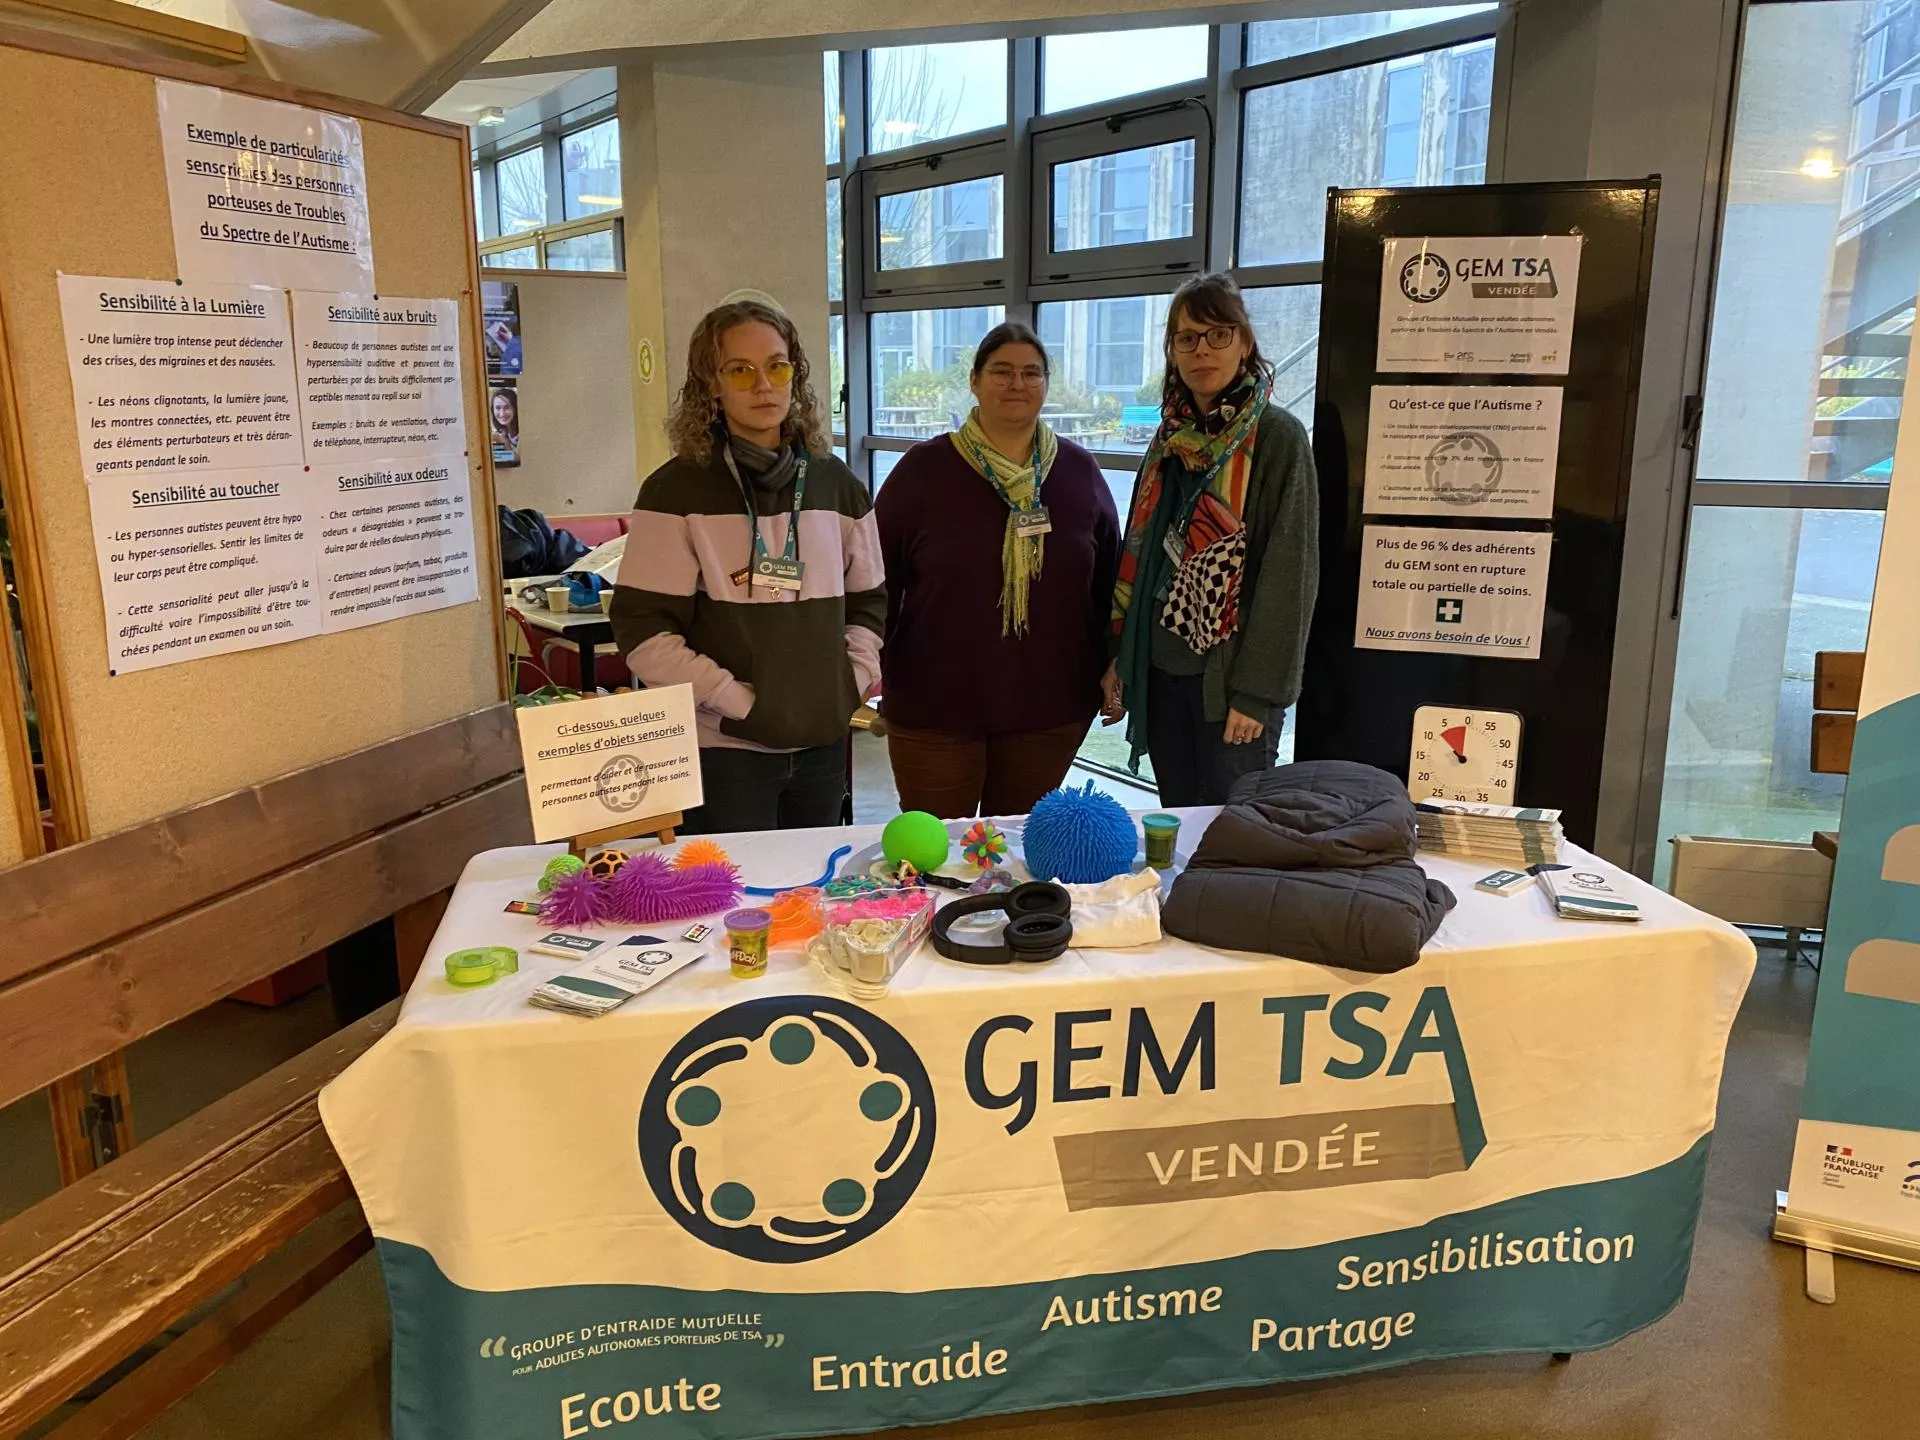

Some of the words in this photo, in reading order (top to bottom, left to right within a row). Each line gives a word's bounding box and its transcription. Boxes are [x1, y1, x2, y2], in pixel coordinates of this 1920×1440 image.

[187, 123, 246, 148] Exemple
[251, 135, 266, 150] de
[270, 140, 350, 165] particularités
[296, 175, 354, 194] personnes
[207, 194, 272, 213] porteuses
[276, 200, 291, 215] de
[295, 202, 345, 222] Troubles
[200, 222, 218, 238] du
[222, 224, 270, 244] Spectre
[274, 230, 289, 244] de
[1456, 258, 1503, 282] GEM
[1488, 285, 1536, 295] VENDÉE
[100, 292, 176, 311] Sensibilité
[181, 297, 189, 311] à
[194, 298, 206, 311] la
[211, 299, 264, 315] Lumière
[328, 306, 380, 321] Sensibilité
[383, 313, 403, 322] aux
[407, 310, 437, 323] bruits
[88, 334, 109, 344] Une
[113, 335, 150, 345] lumière
[154, 337, 174, 346] trop
[177, 336, 211, 346] intense
[215, 337, 236, 348] peut
[239, 337, 283, 348] déclencher
[83, 355, 101, 365] des
[105, 356, 136, 367] crises,
[140, 356, 155, 366] des
[159, 357, 205, 368] migraines
[208, 358, 218, 366] et
[221, 357, 236, 366] des
[239, 358, 275, 366] nausées.
[98, 397, 114, 406] Les
[120, 396, 149, 406] néons
[154, 395, 209, 407] clignotants,
[214, 395, 222, 404] la
[226, 393, 260, 404] lumière
[263, 394, 288, 405] jaune,
[1449, 402, 1470, 411] que
[1536, 401, 1542, 410] ?
[91, 418, 105, 427] les
[112, 417, 153, 427] montres
[157, 415, 212, 426] connectées,
[216, 415, 232, 423] etc.
[237, 414, 271, 424] peuvent
[275, 413, 290, 421] être
[94, 439, 112, 449] des
[117, 436, 162, 448] éléments
[166, 434, 229, 446] perturbateurs
[234, 434, 242, 442] et
[246, 432, 262, 441] très
[266, 431, 292, 440] déran-
[96, 460, 132, 472] geants
[136, 457, 175, 470] pendant
[178, 456, 186, 465] le
[189, 455, 210, 464] soin.
[338, 471, 392, 488] Sensibilité
[395, 472, 412, 482] aux
[417, 468, 448, 480] odeurs
[132, 485, 205, 505] Sensibilité
[210, 488, 226, 498] au
[230, 481, 279, 497] toucher
[116, 531, 131, 541] Les
[135, 526, 184, 541] personnes
[187, 521, 223, 533] autistes
[226, 517, 260, 530] peuvent
[264, 515, 279, 524] être
[282, 513, 301, 524] hypo
[1376, 539, 1399, 549] Plus
[1403, 540, 1416, 550] de
[1421, 541, 1435, 550] 96
[1438, 541, 1448, 551] %
[1452, 542, 1472, 552] des
[1475, 543, 1535, 555] adhérents
[1385, 560, 1399, 569] du
[1403, 561, 1430, 570] GEM
[1434, 563, 1459, 571] sont
[1463, 565, 1477, 573] en
[1481, 565, 1525, 576] rupture
[1373, 580, 1406, 589] totale
[1410, 582, 1424, 590] ou
[1428, 582, 1476, 593] partielle
[1480, 585, 1494, 594] de
[1498, 586, 1531, 596] soins.
[1366, 627, 1394, 638] Nous
[1398, 631, 1431, 640] avons
[1434, 631, 1472, 643] besoin
[1476, 634, 1490, 644] de
[1495, 635, 1521, 645] Vous
[1526, 636, 1530, 645] !
[557, 718, 618, 735] Ci-dessous,
[620, 710, 665, 725] quelques
[1465, 717, 1470, 725] 0
[1485, 722, 1496, 730] 55
[538, 743, 590, 759] exemples
[638, 724, 685, 741] sensoriels
[1499, 740, 1511, 748] 50
[1502, 760, 1513, 768] 45
[541, 775, 591, 792] permettant
[624, 767, 631, 775] et
[634, 764, 643, 772] de
[645, 759, 677, 770] rassurer
[679, 756, 689, 764] les
[1418, 772, 1429, 780] 20
[542, 793, 587, 808] personnes
[590, 784, 620, 798] autistes
[623, 777, 655, 791] pendant
[657, 775, 668, 783] les
[670, 771, 691, 780] soins.
[1432, 788, 1443, 797] 25
[1477, 793, 1488, 801] 35
[964, 1002, 1215, 1136] GEM
[1146, 1123, 1380, 1184] VENDÉE
[1824, 1163, 1879, 1179] FRANÇAISE
[1825, 1155, 1884, 1172] RÉPUBLIQUE
[1336, 1228, 1635, 1290] Sensibilisation
[1041, 1282, 1223, 1330] Autisme
[511, 1332, 575, 1360] GROUPE
[581, 1318, 676, 1341] D'ENTRAIDE
[682, 1314, 762, 1330] MUTUELLE
[1251, 1308, 1416, 1353] Partage
[512, 1365, 532, 1375] POUR
[535, 1349, 584, 1370] ADULTES
[587, 1335, 660, 1356] AUTONOMES
[664, 1333, 721, 1345] PORTEURS
[724, 1331, 739, 1341] DE
[741, 1330, 762, 1340] TSA
[812, 1341, 1008, 1391] Entraide
[561, 1377, 721, 1439] Ecoute
